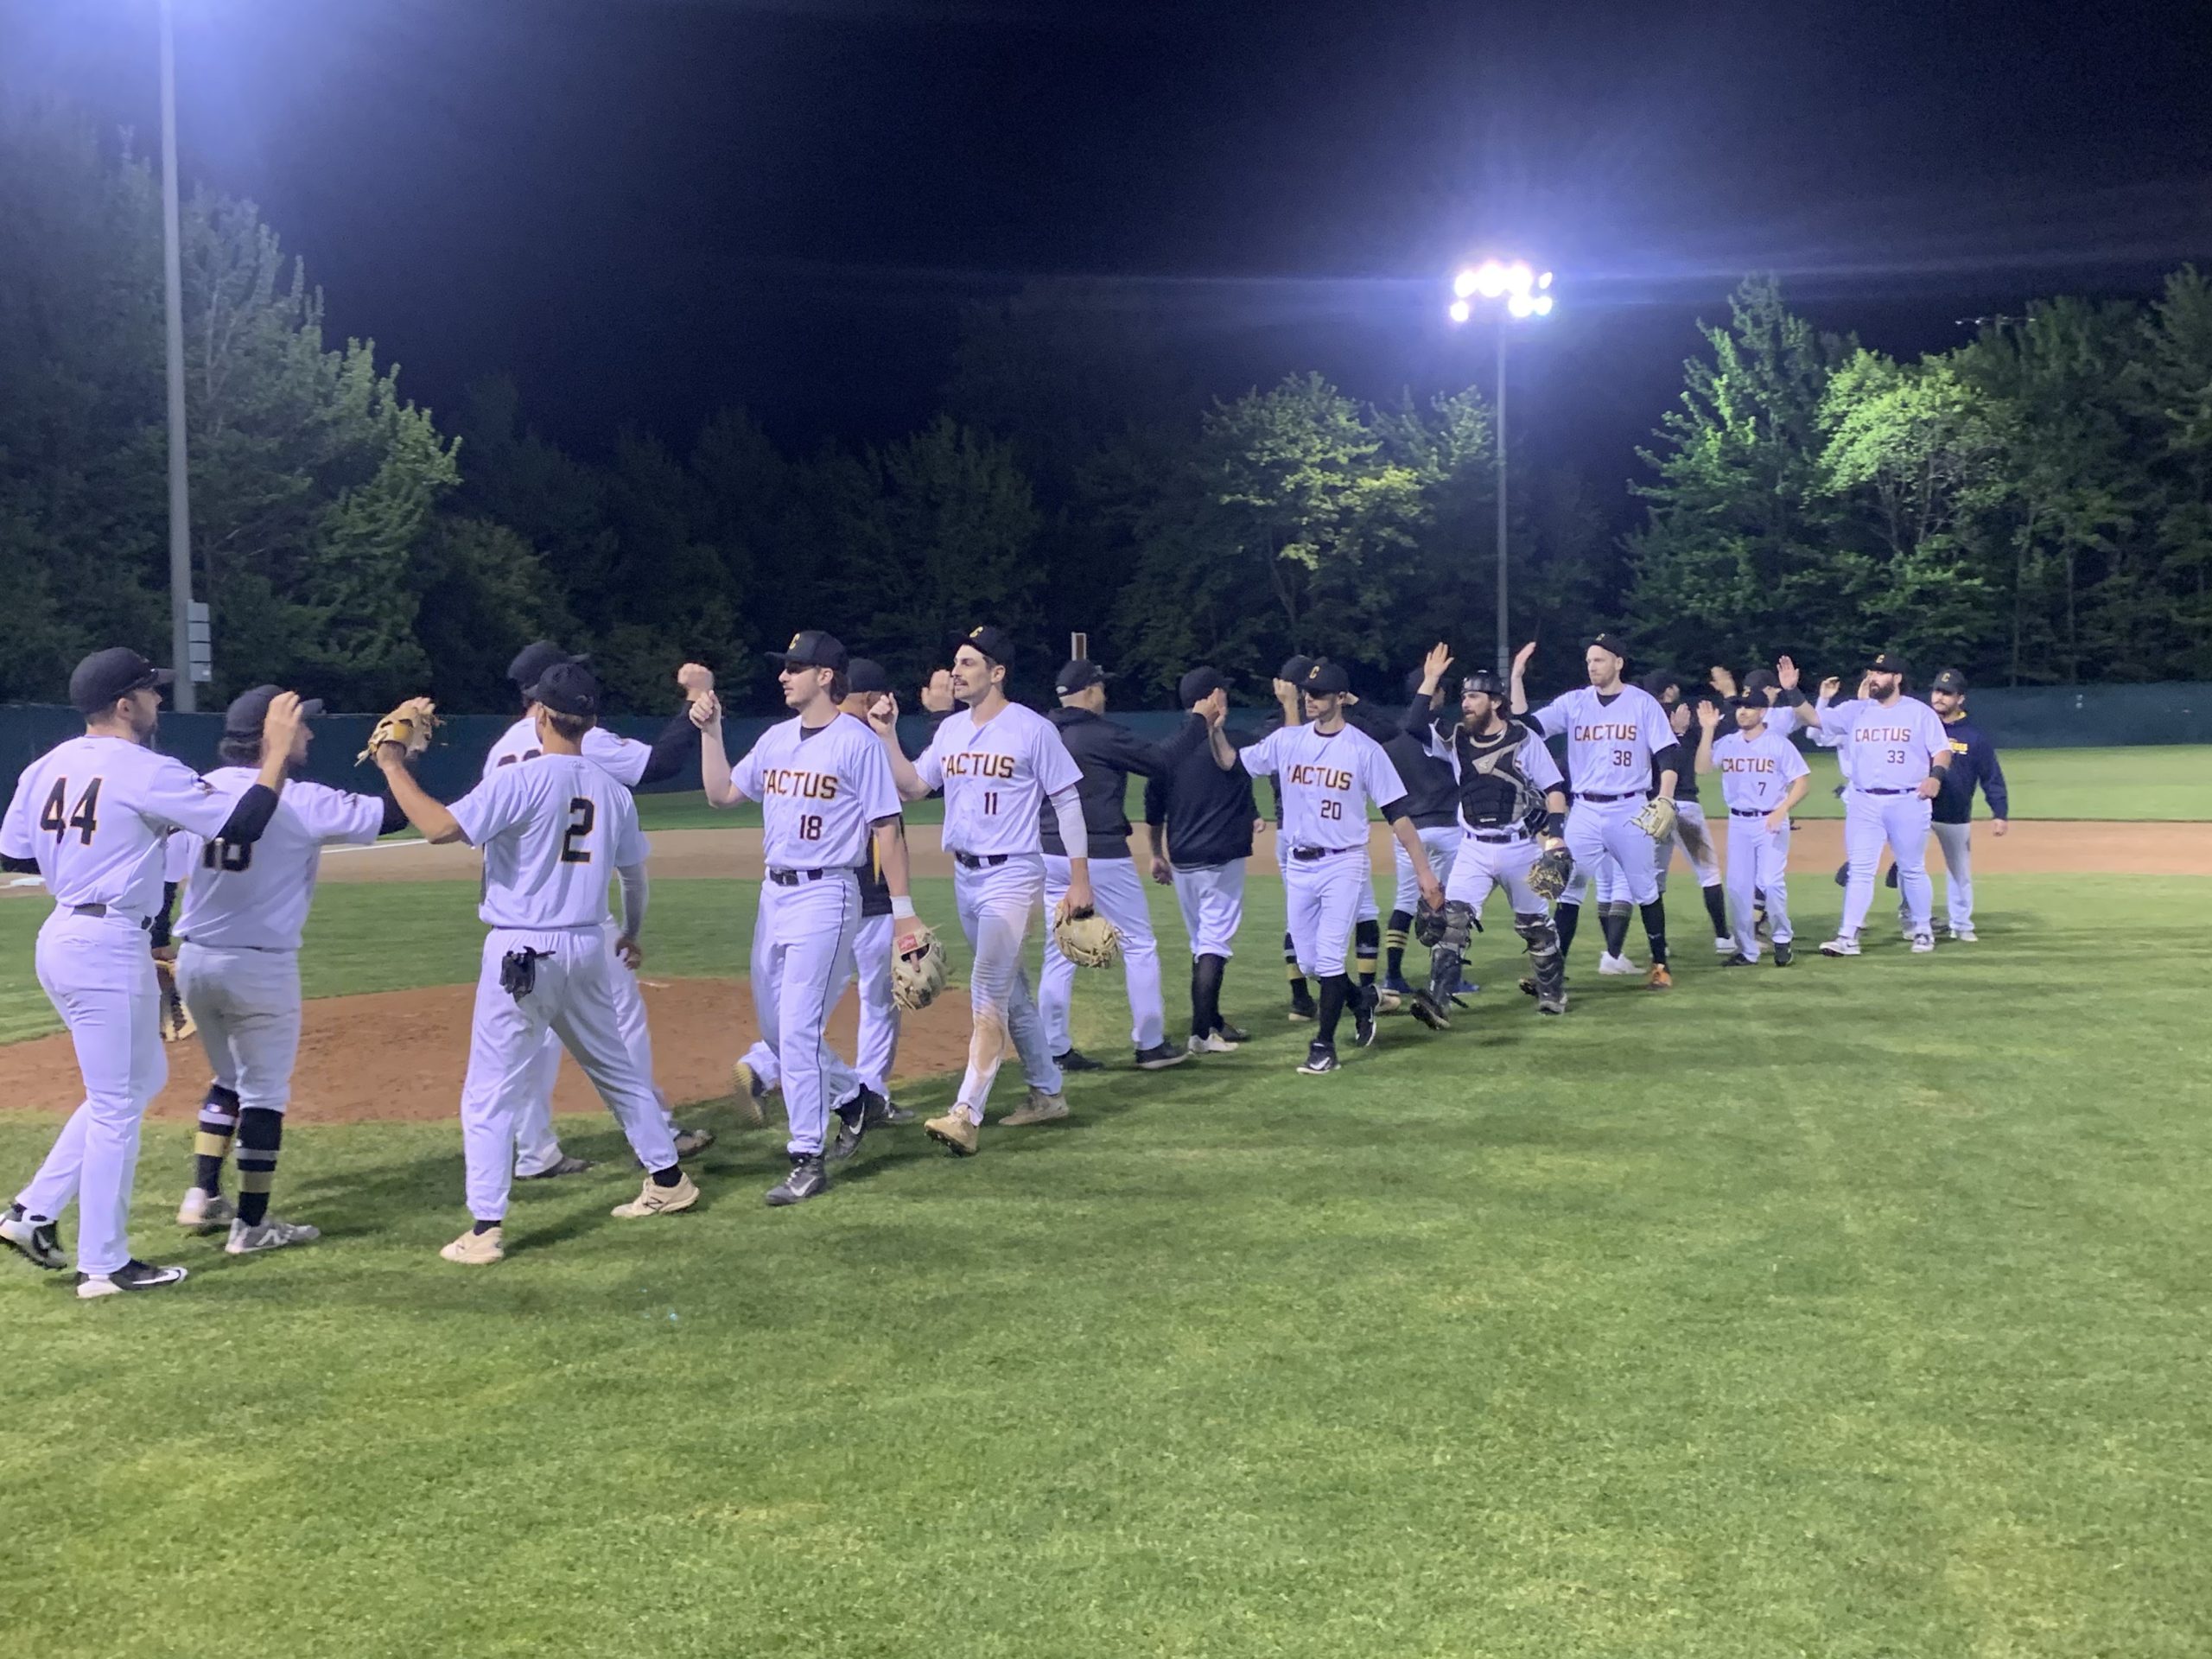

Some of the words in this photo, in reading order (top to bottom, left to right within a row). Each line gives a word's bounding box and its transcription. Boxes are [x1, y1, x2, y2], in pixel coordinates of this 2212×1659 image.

[789, 632, 801, 650] C
[1309, 665, 1320, 679] C
[1941, 672, 1951, 683] C
[1574, 724, 1637, 741] CACTUS
[1855, 728, 1911, 743] CACTUS
[941, 753, 1015, 779] ACTUS
[1612, 749, 1632, 767] 38
[1721, 758, 1775, 774] CACTUS
[1886, 750, 1906, 765] 33
[1287, 764, 1353, 791] ACTUS
[1758, 781, 1767, 797] 7
[40, 777, 103, 846] 44
[984, 791, 998, 816] 11
[1320, 798, 1342, 821] 20
[561, 797, 595, 862] 2
[799, 814, 823, 841] 18
